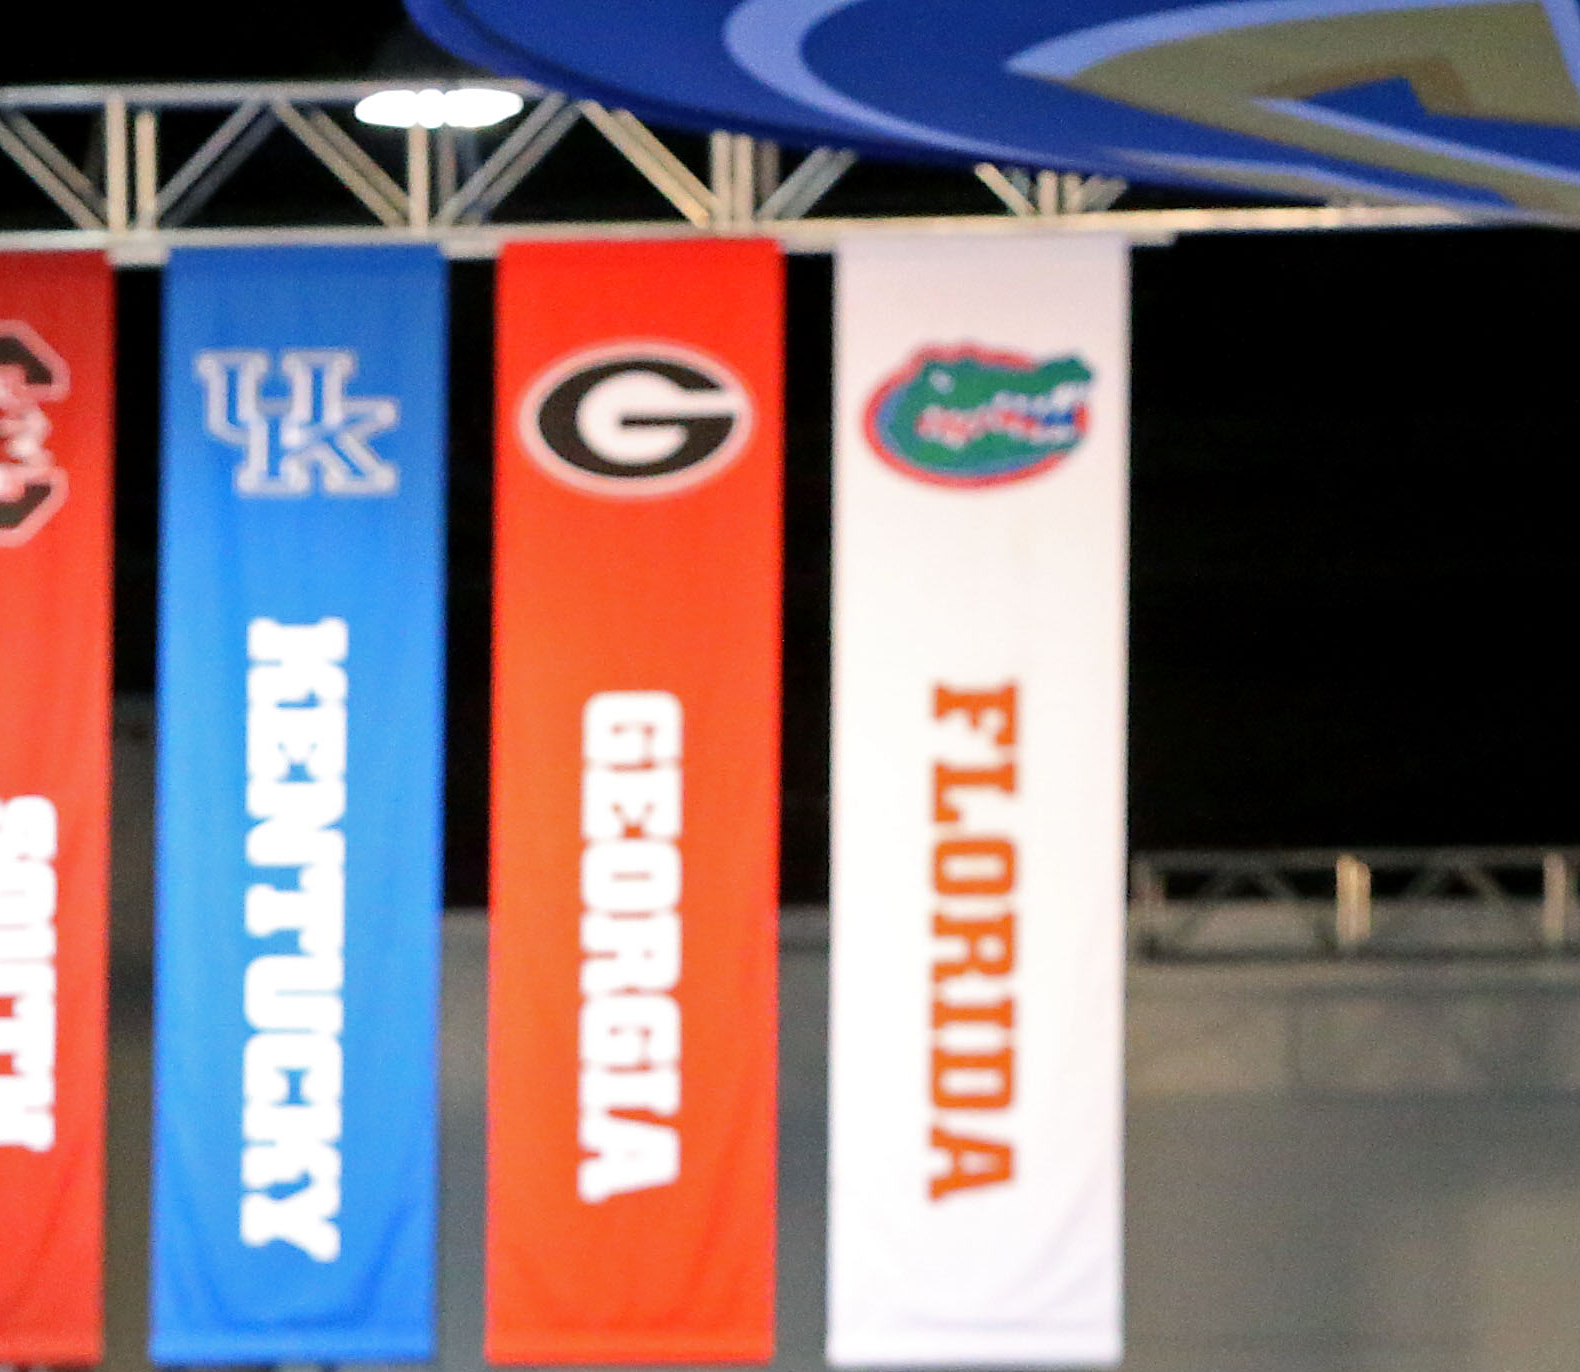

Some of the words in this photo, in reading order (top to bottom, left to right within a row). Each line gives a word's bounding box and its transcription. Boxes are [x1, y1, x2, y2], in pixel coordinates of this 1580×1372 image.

[194, 350, 402, 497] UK
[532, 352, 741, 484] G
[239, 617, 348, 1263] KENTUCKY
[577, 688, 684, 1204] GEORGIA
[928, 680, 1020, 1206] FLORIDA
